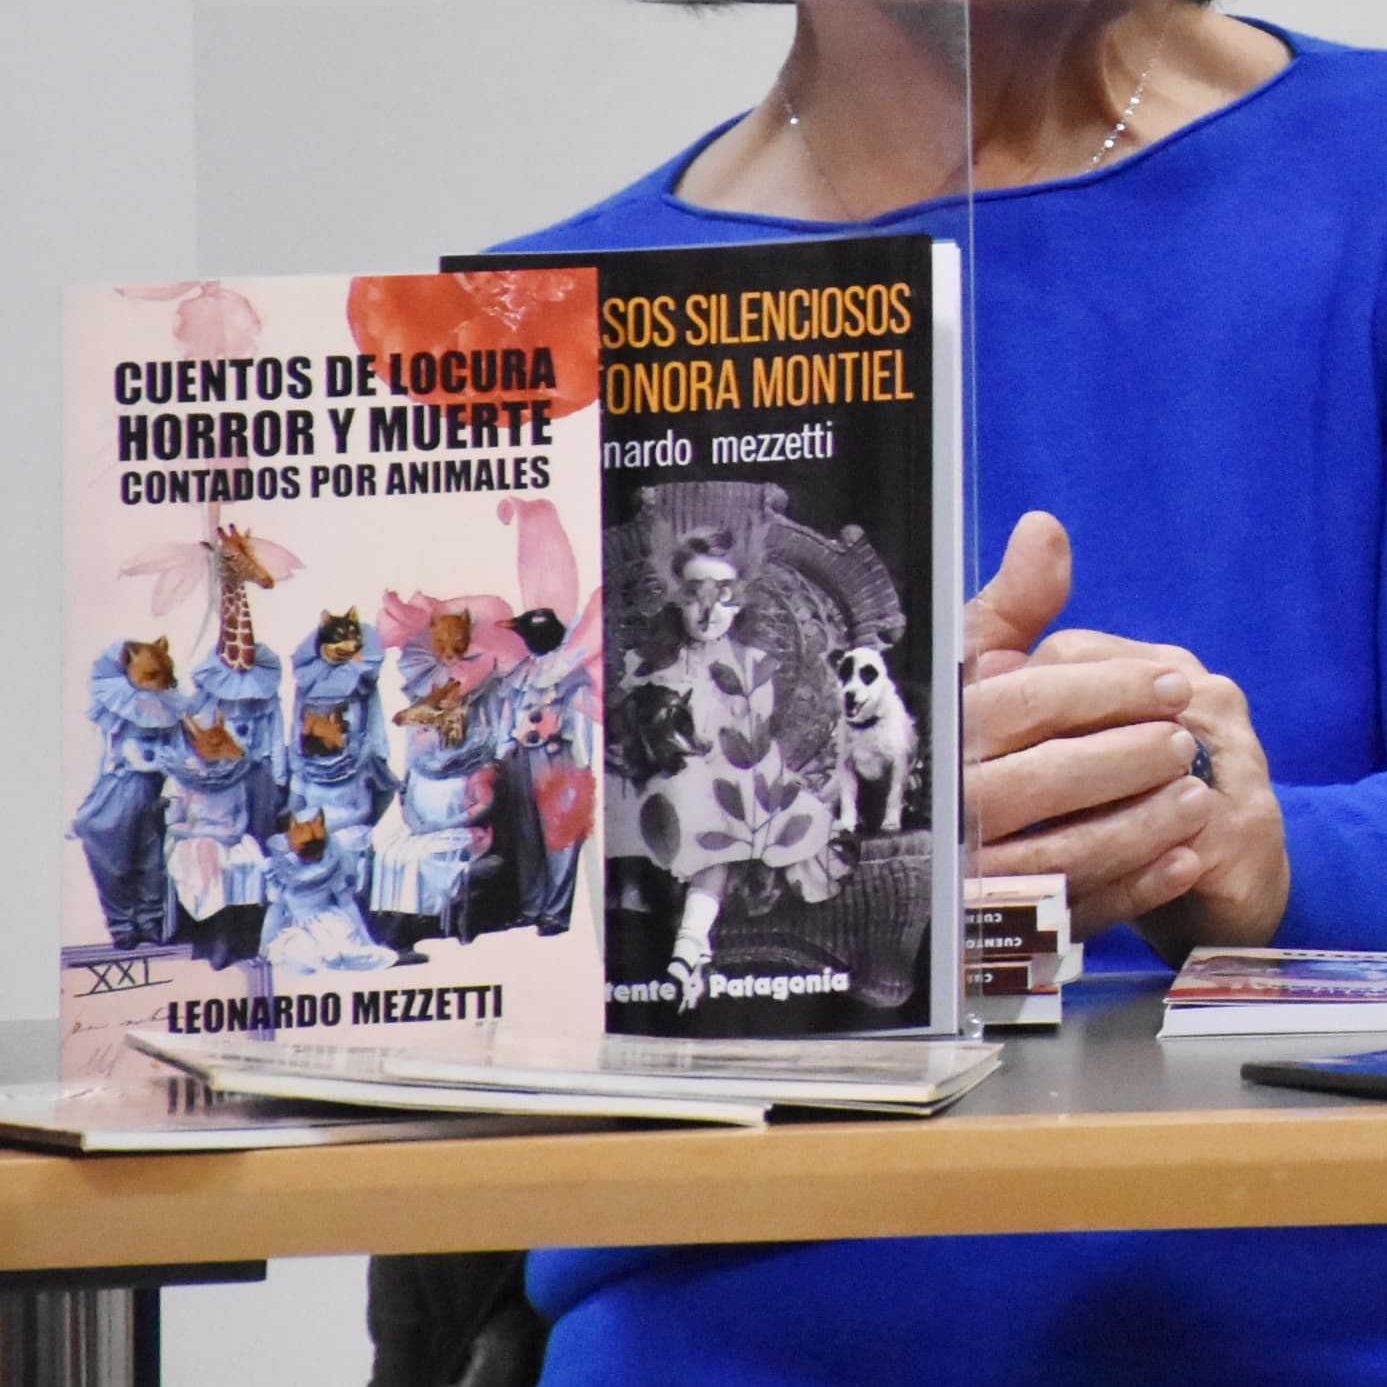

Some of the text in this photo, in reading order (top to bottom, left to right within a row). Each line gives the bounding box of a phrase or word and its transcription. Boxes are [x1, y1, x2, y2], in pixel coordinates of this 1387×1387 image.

[602, 282, 912, 349] SOS SILENCIOSOS
[115, 347, 557, 405] CUENTOS DE LOCURA
[605, 349, 915, 414] ONORA MONTIEL
[118, 399, 553, 461] HORROR Y MUERTE
[603, 421, 834, 469] nardo mezzetti
[120, 455, 550, 505] CONTADOS POR ANIMALES
[965, 936, 1023, 948] CUENTO
[167, 991, 342, 1035] LEONARDO
[351, 983, 503, 1027] MEZZETTI
[709, 966, 849, 1001] Patagonia
